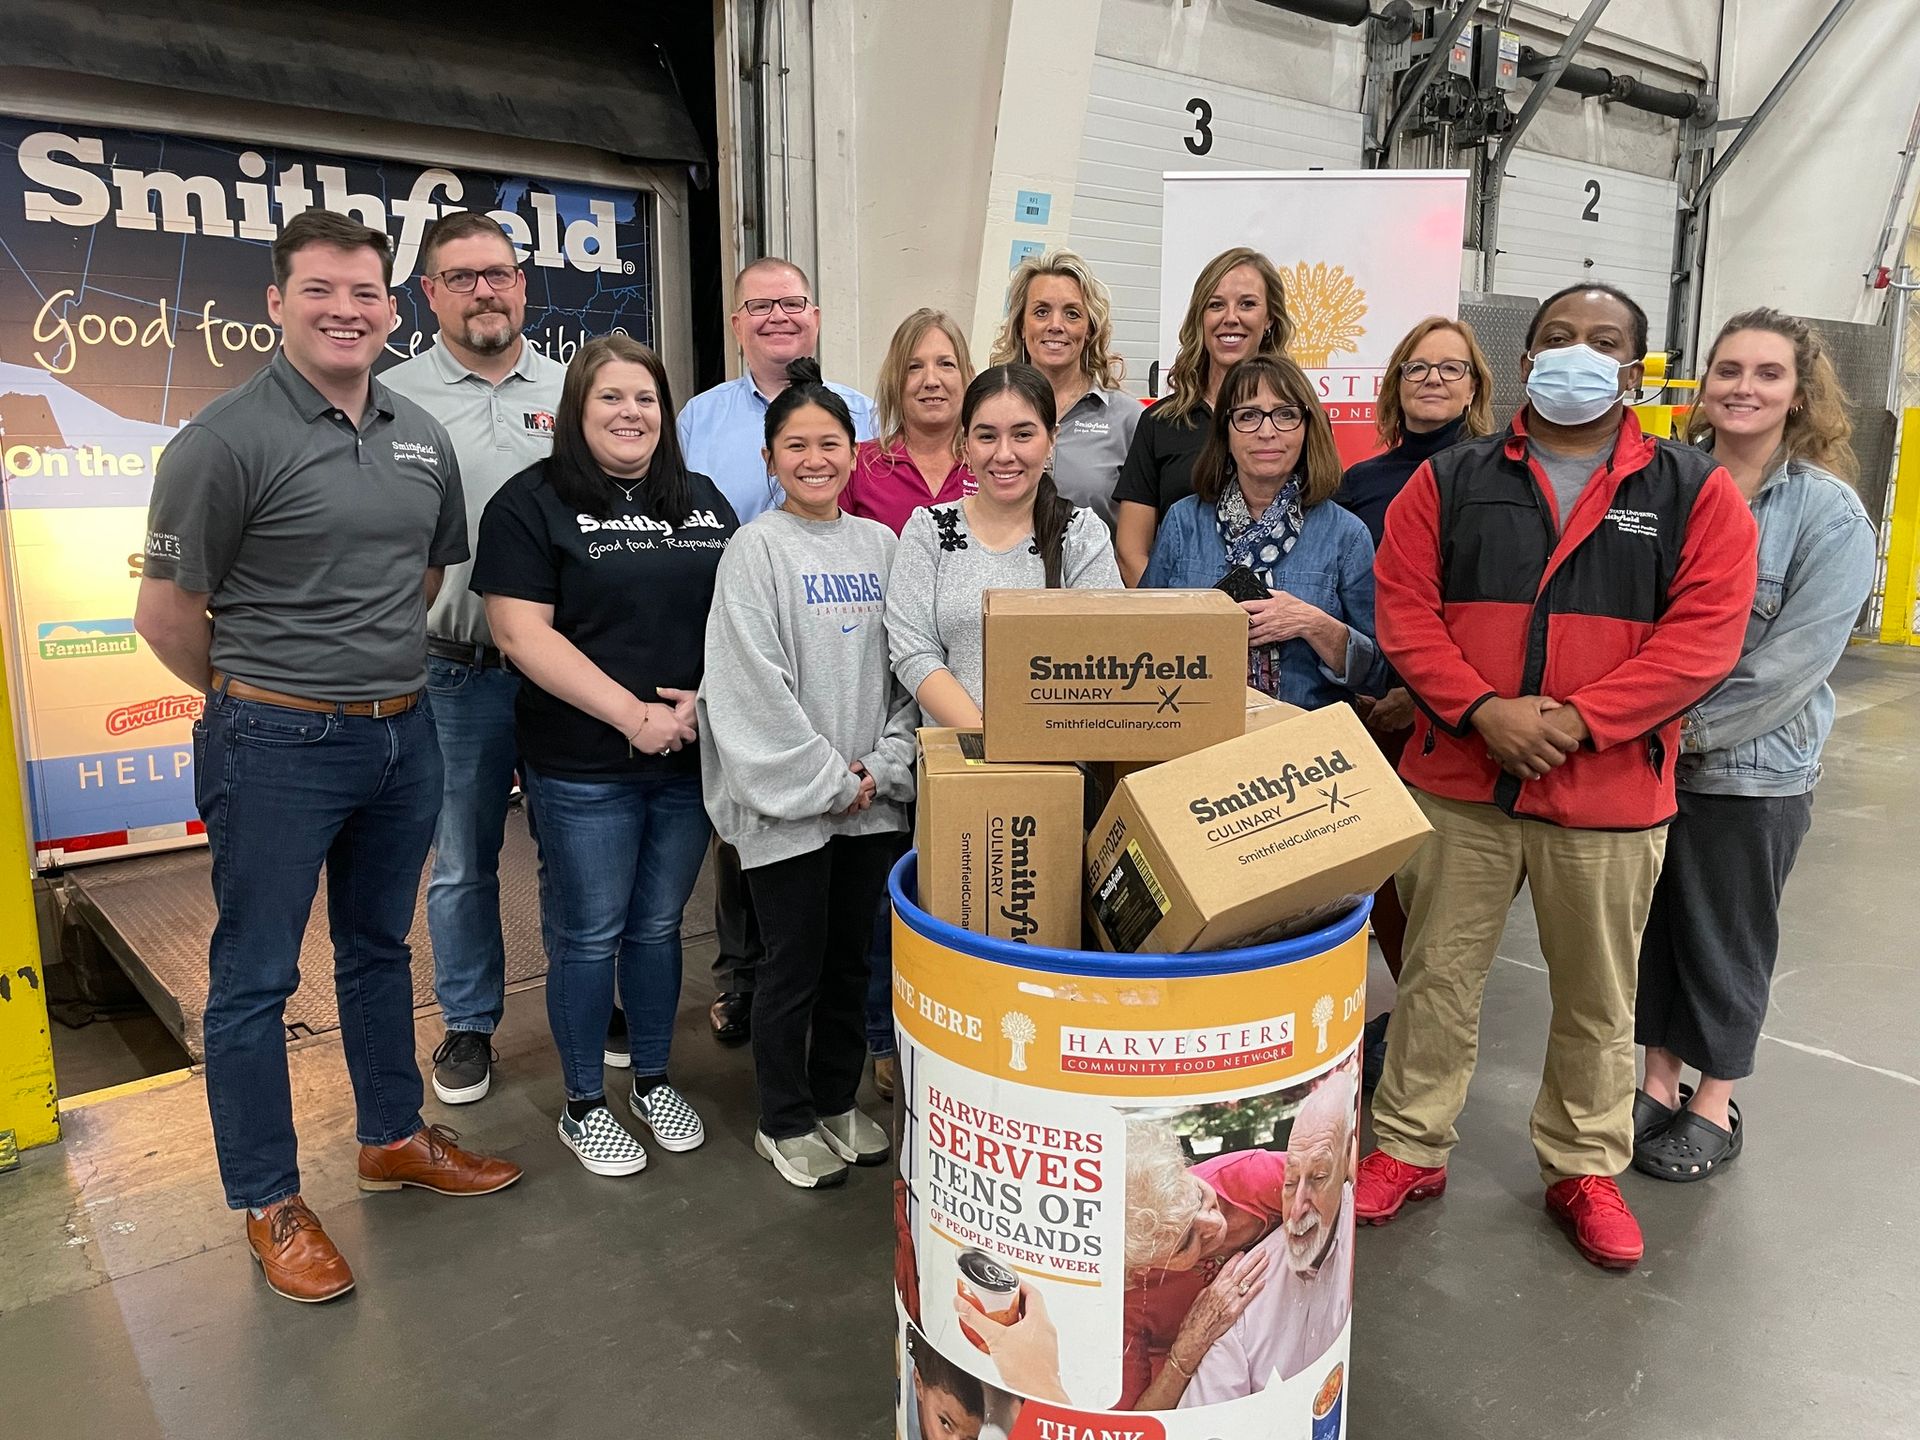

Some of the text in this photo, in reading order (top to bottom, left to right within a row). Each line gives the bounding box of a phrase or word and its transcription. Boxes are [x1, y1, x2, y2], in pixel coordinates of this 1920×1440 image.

[1183, 97, 1213, 156] 3
[1581, 179, 1601, 222] 2
[33, 289, 176, 375] Good
[196, 300, 284, 368] foo
[5, 444, 69, 477] On
[76, 445, 145, 477] the
[588, 541, 622, 560] Good
[802, 573, 882, 604] KANSAS
[44, 637, 132, 657] Farmland
[1029, 652, 1208, 691] Smithfield
[1030, 688, 1113, 700] CULINARY
[1045, 719, 1181, 731] SmithfieldCulinary.com
[78, 751, 192, 790] HELP
[1189, 749, 1353, 825] Smithfield
[1206, 806, 1283, 842] CULINARY
[1238, 813, 1361, 866] SmithfieldCulinary.com
[991, 816, 1003, 897] CULINARY
[894, 969, 982, 1042] ATE HERE
[1067, 1046, 1288, 1073] COMMUNITY FOOD NETWORK
[1068, 1021, 1289, 1056] HARVESTERS
[928, 1085, 1103, 1154] HARVESTERS
[929, 1112, 1103, 1193] SERVES
[929, 1148, 1102, 1229] TENS OF
[929, 1183, 1103, 1257] THOUSANDS
[930, 1208, 1101, 1274] OF PEOPLE EVERY WEEK
